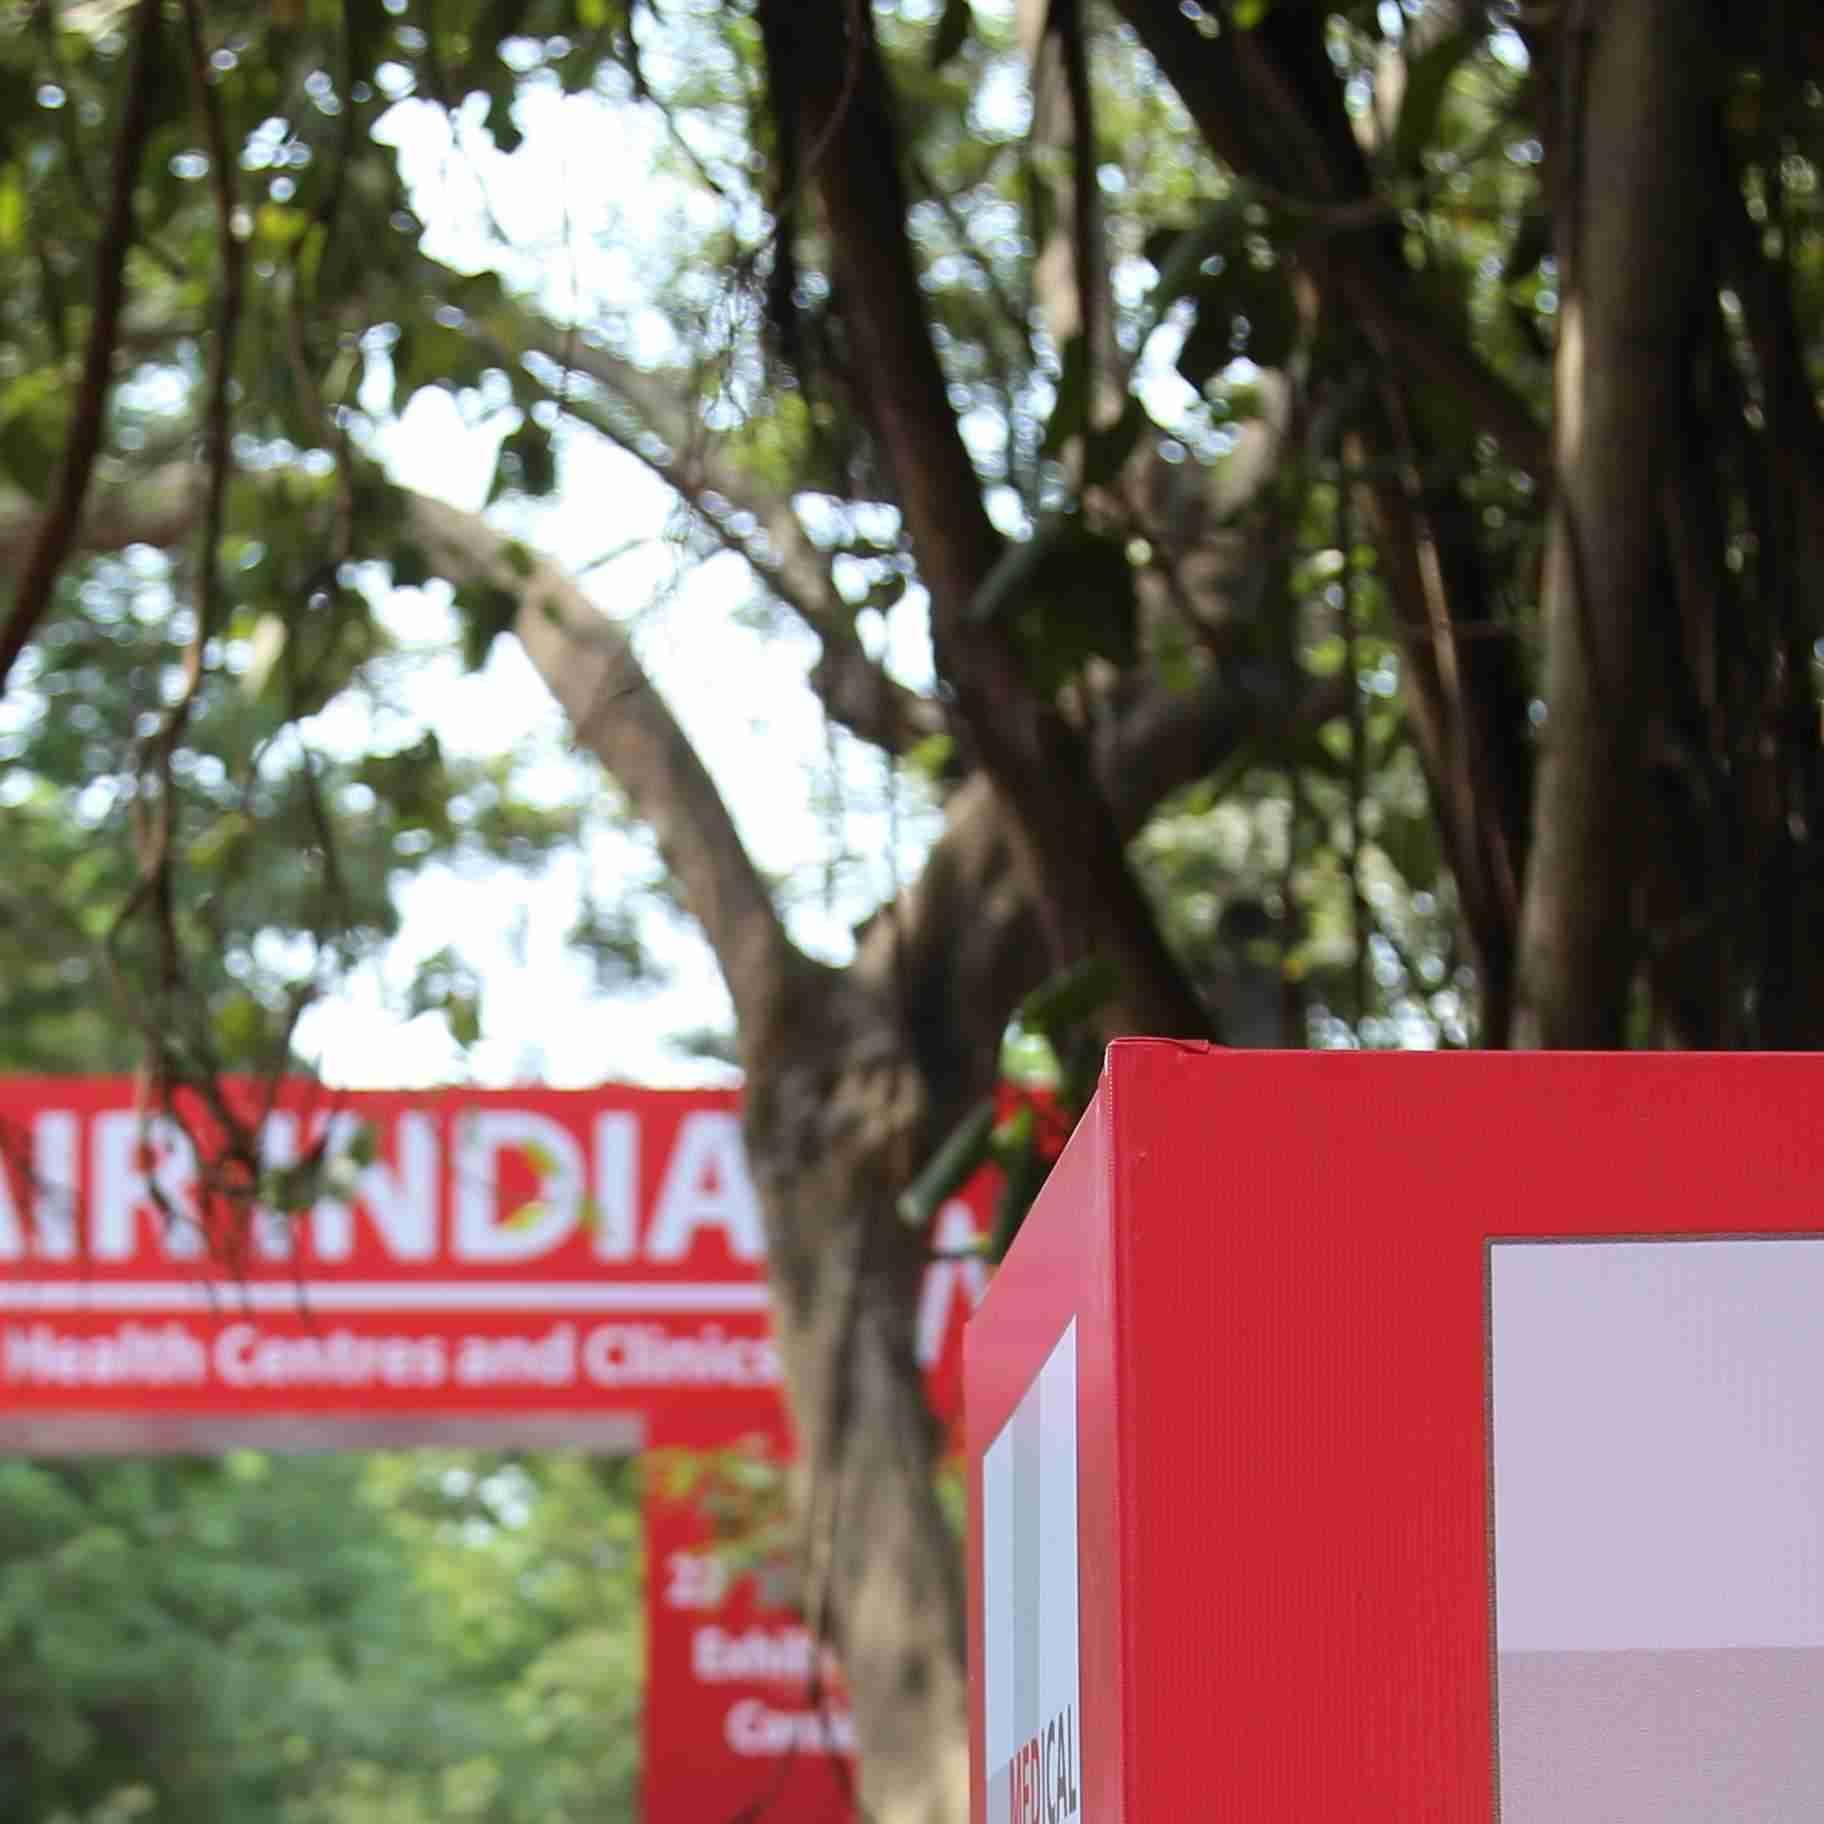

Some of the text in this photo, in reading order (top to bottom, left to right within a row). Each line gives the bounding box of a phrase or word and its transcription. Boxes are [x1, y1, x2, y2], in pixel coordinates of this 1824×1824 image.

[253, 1108, 769, 1266] INDIA
[0, 1321, 206, 1388] Health
[213, 1322, 448, 1389] Centres
[456, 1322, 575, 1388] and
